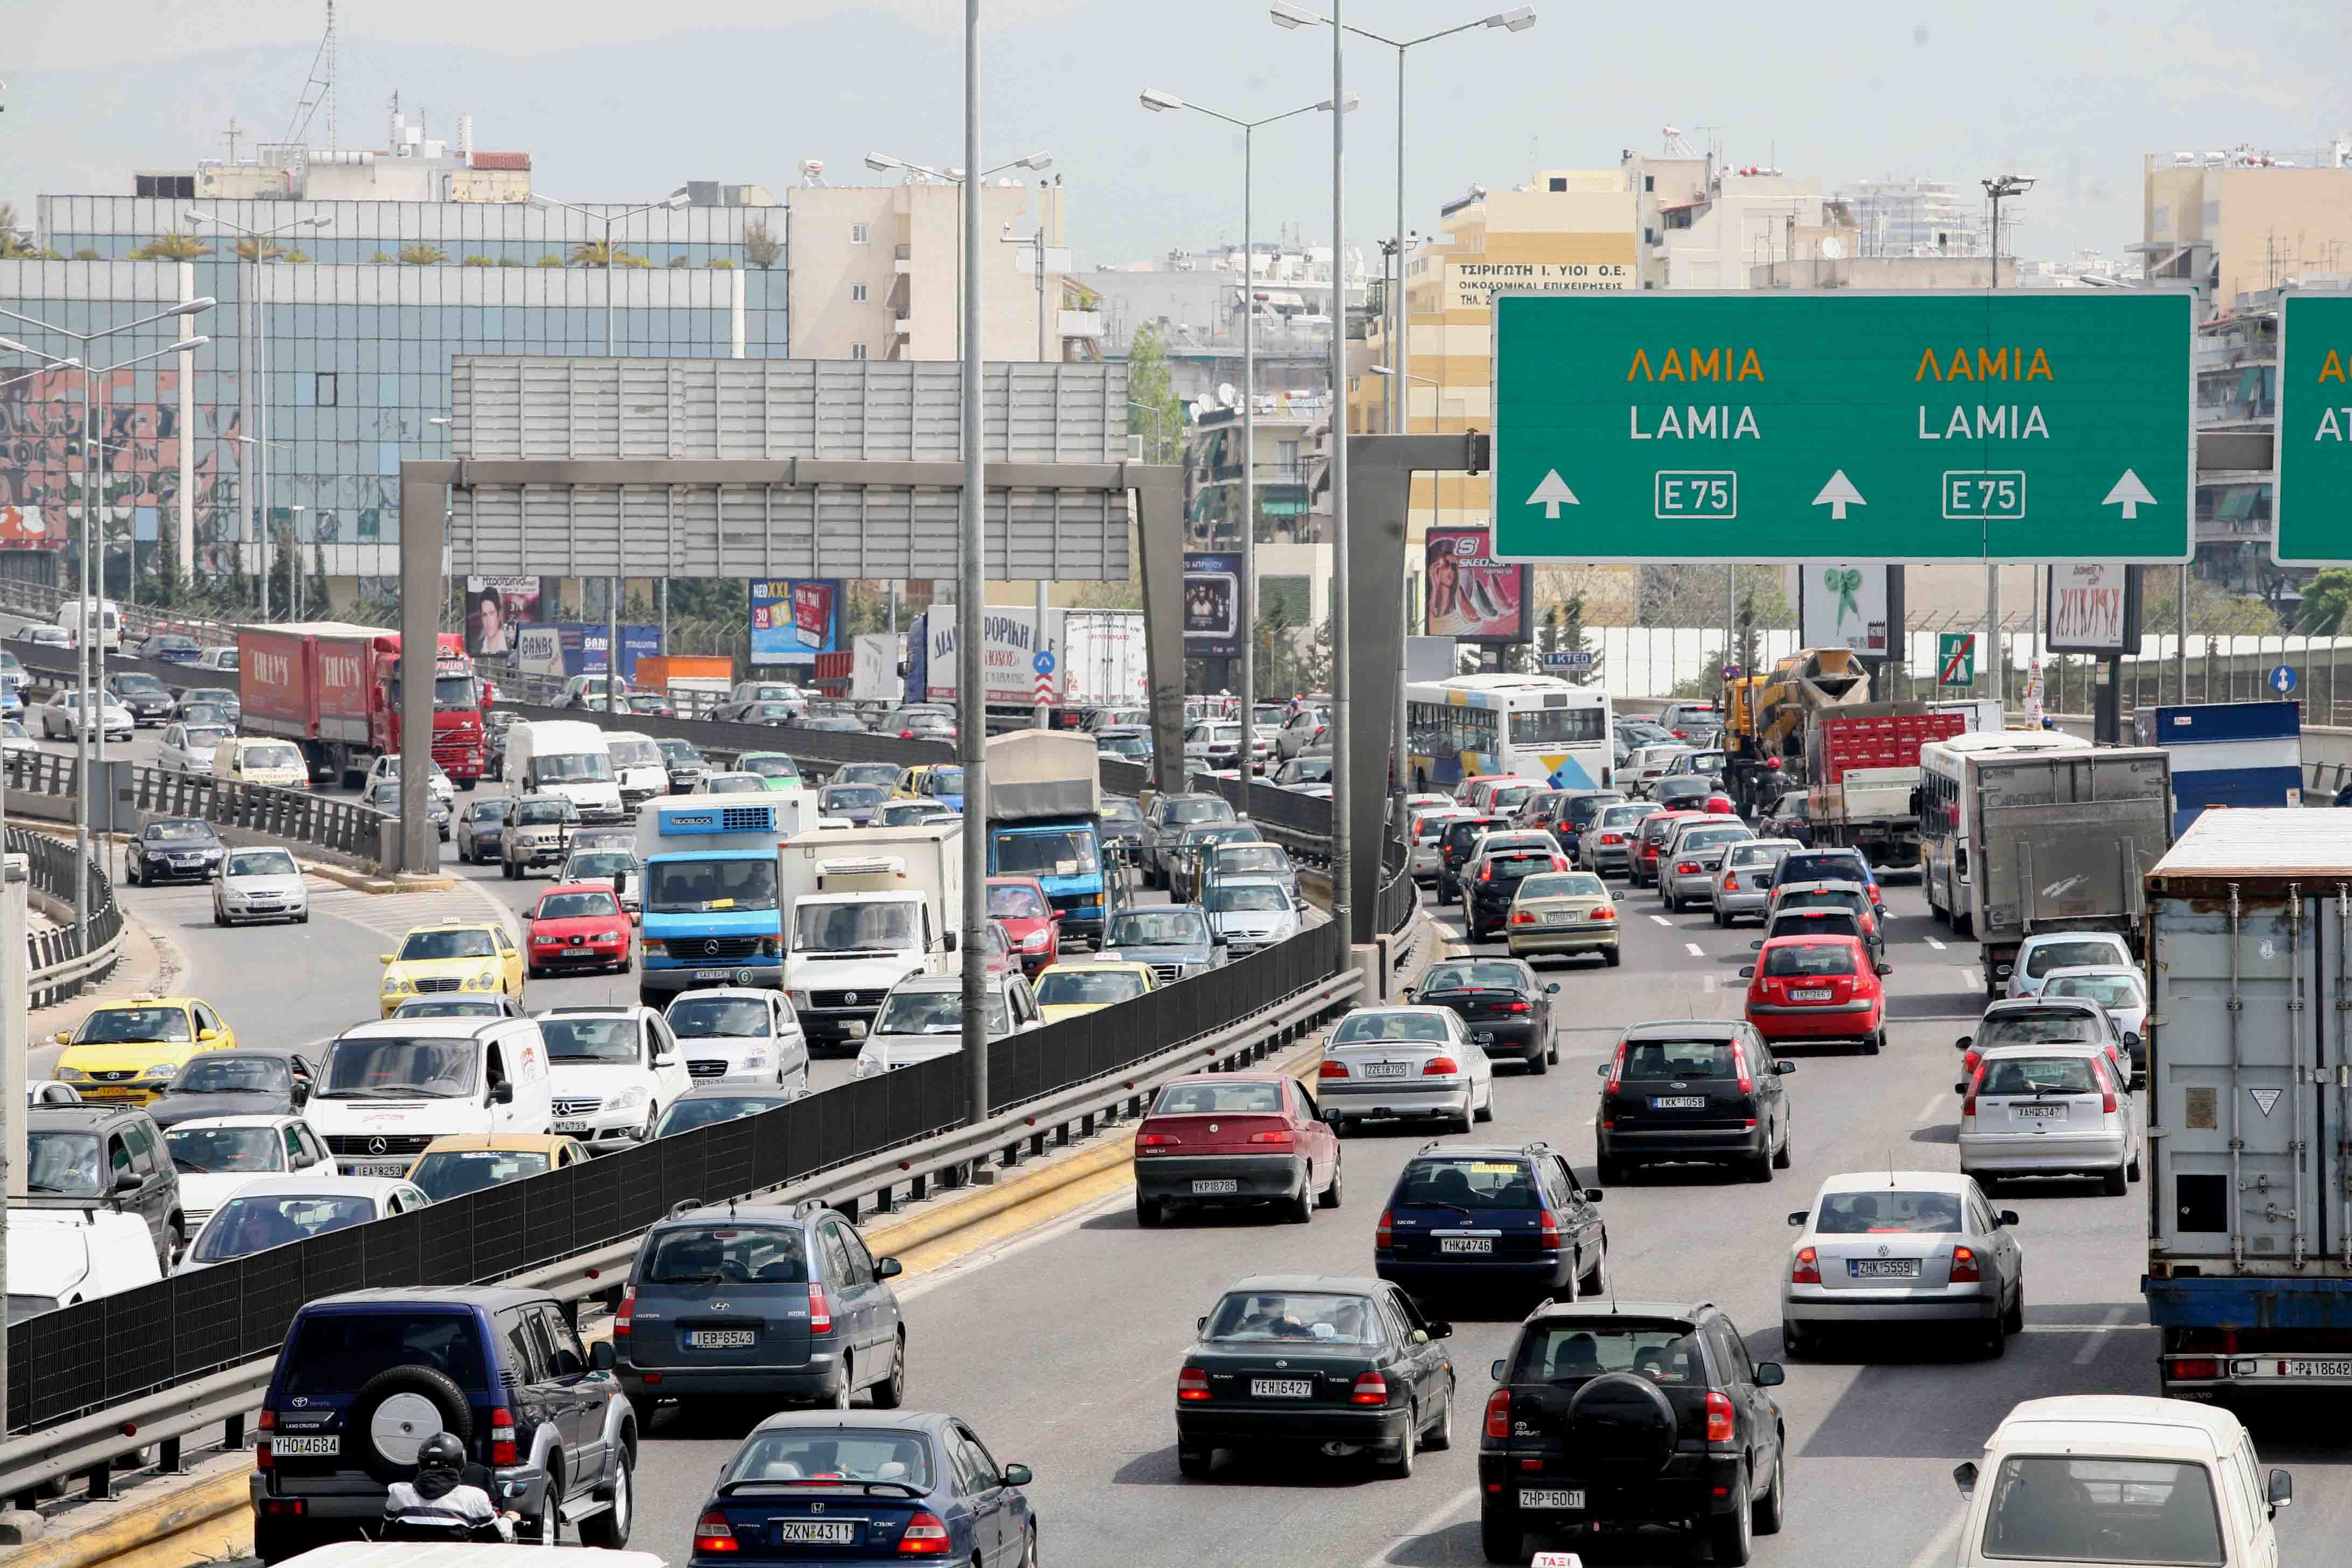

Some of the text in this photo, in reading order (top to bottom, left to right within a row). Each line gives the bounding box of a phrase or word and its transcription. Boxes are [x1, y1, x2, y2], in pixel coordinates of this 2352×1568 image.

[1460, 265, 1533, 276] ΤΣΙΡΙΓΩΤΗ
[1559, 266, 1587, 276] ΥΙΟΙ
[1599, 266, 1626, 276] Ο.Ε.
[1461, 295, 1490, 305] ΤΗΛ. 2
[1628, 348, 1765, 382] ΛΑΜΙΑ
[1916, 348, 2054, 381] ΛΑΜΙΑ
[2319, 350, 2352, 383] Α
[1631, 405, 1760, 439] LAMIA
[1920, 405, 2049, 439] LAMIA
[768, 582, 792, 598] XXL
[741, 971, 749, 981] G
[359, 1167, 401, 1176] IEA-8253
[697, 1333, 753, 1344] IEB-6543
[1522, 1492, 1580, 1506] ZHP-6001
[1541, 1557, 1571, 1566] ΤΑΞΙ
